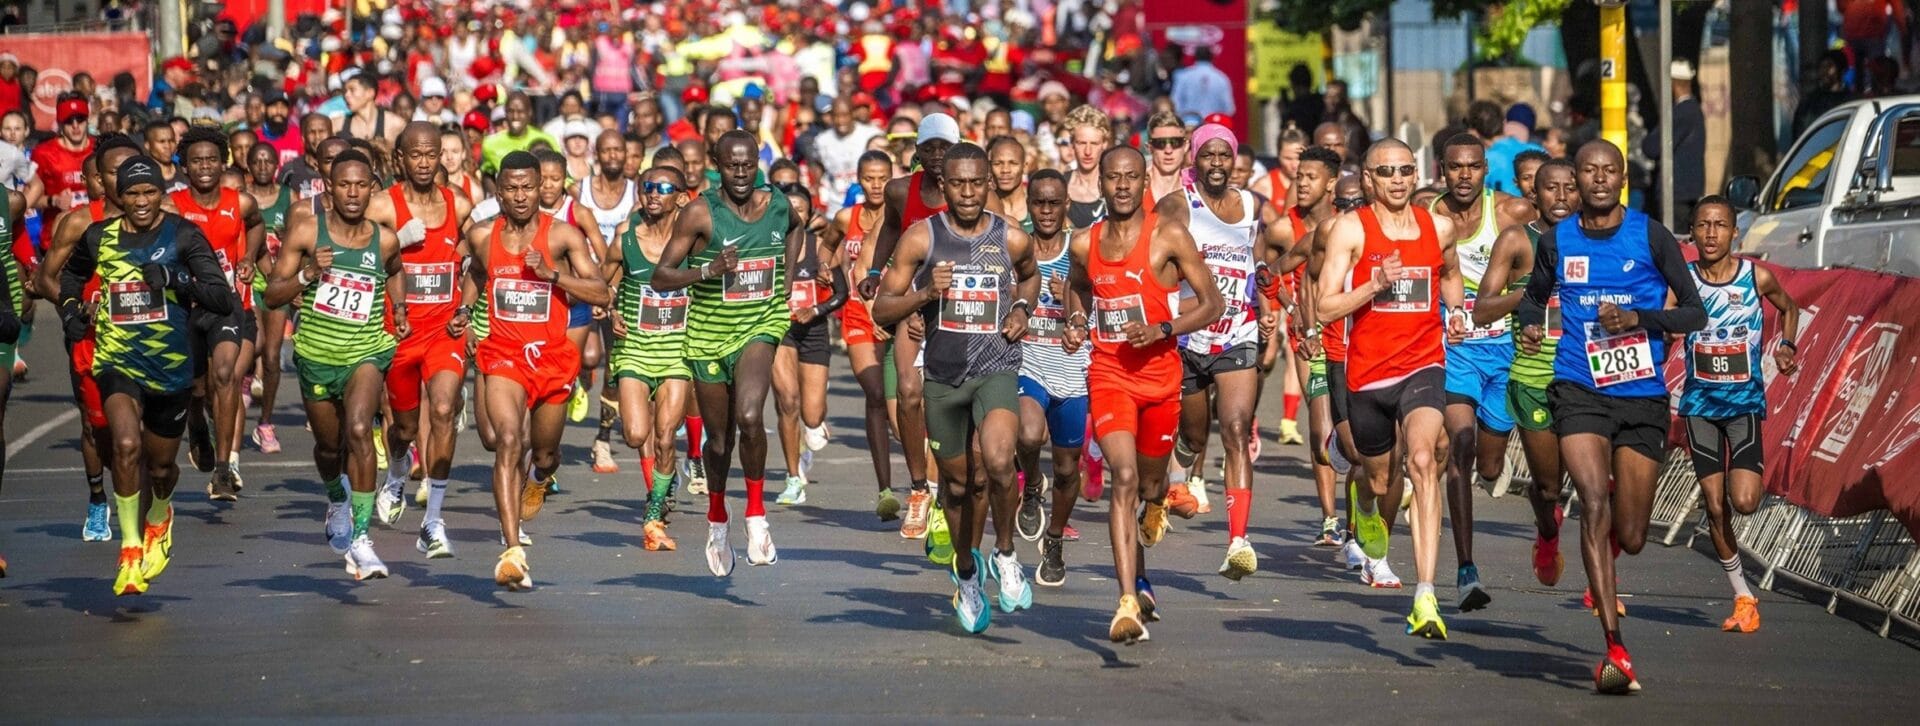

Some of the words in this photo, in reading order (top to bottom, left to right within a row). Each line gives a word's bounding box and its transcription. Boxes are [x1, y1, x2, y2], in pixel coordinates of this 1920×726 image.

[739, 270, 763, 285] SAMMY
[1566, 261, 1585, 278] 45
[415, 273, 441, 288] TUMELO
[1391, 279, 1414, 294] ELROY
[326, 286, 362, 312] 213
[504, 290, 537, 306] PRECIOUS
[658, 307, 673, 319] TETE
[955, 300, 985, 317] EDWARD
[1601, 346, 1640, 375] 283
[1712, 356, 1729, 372] 95
